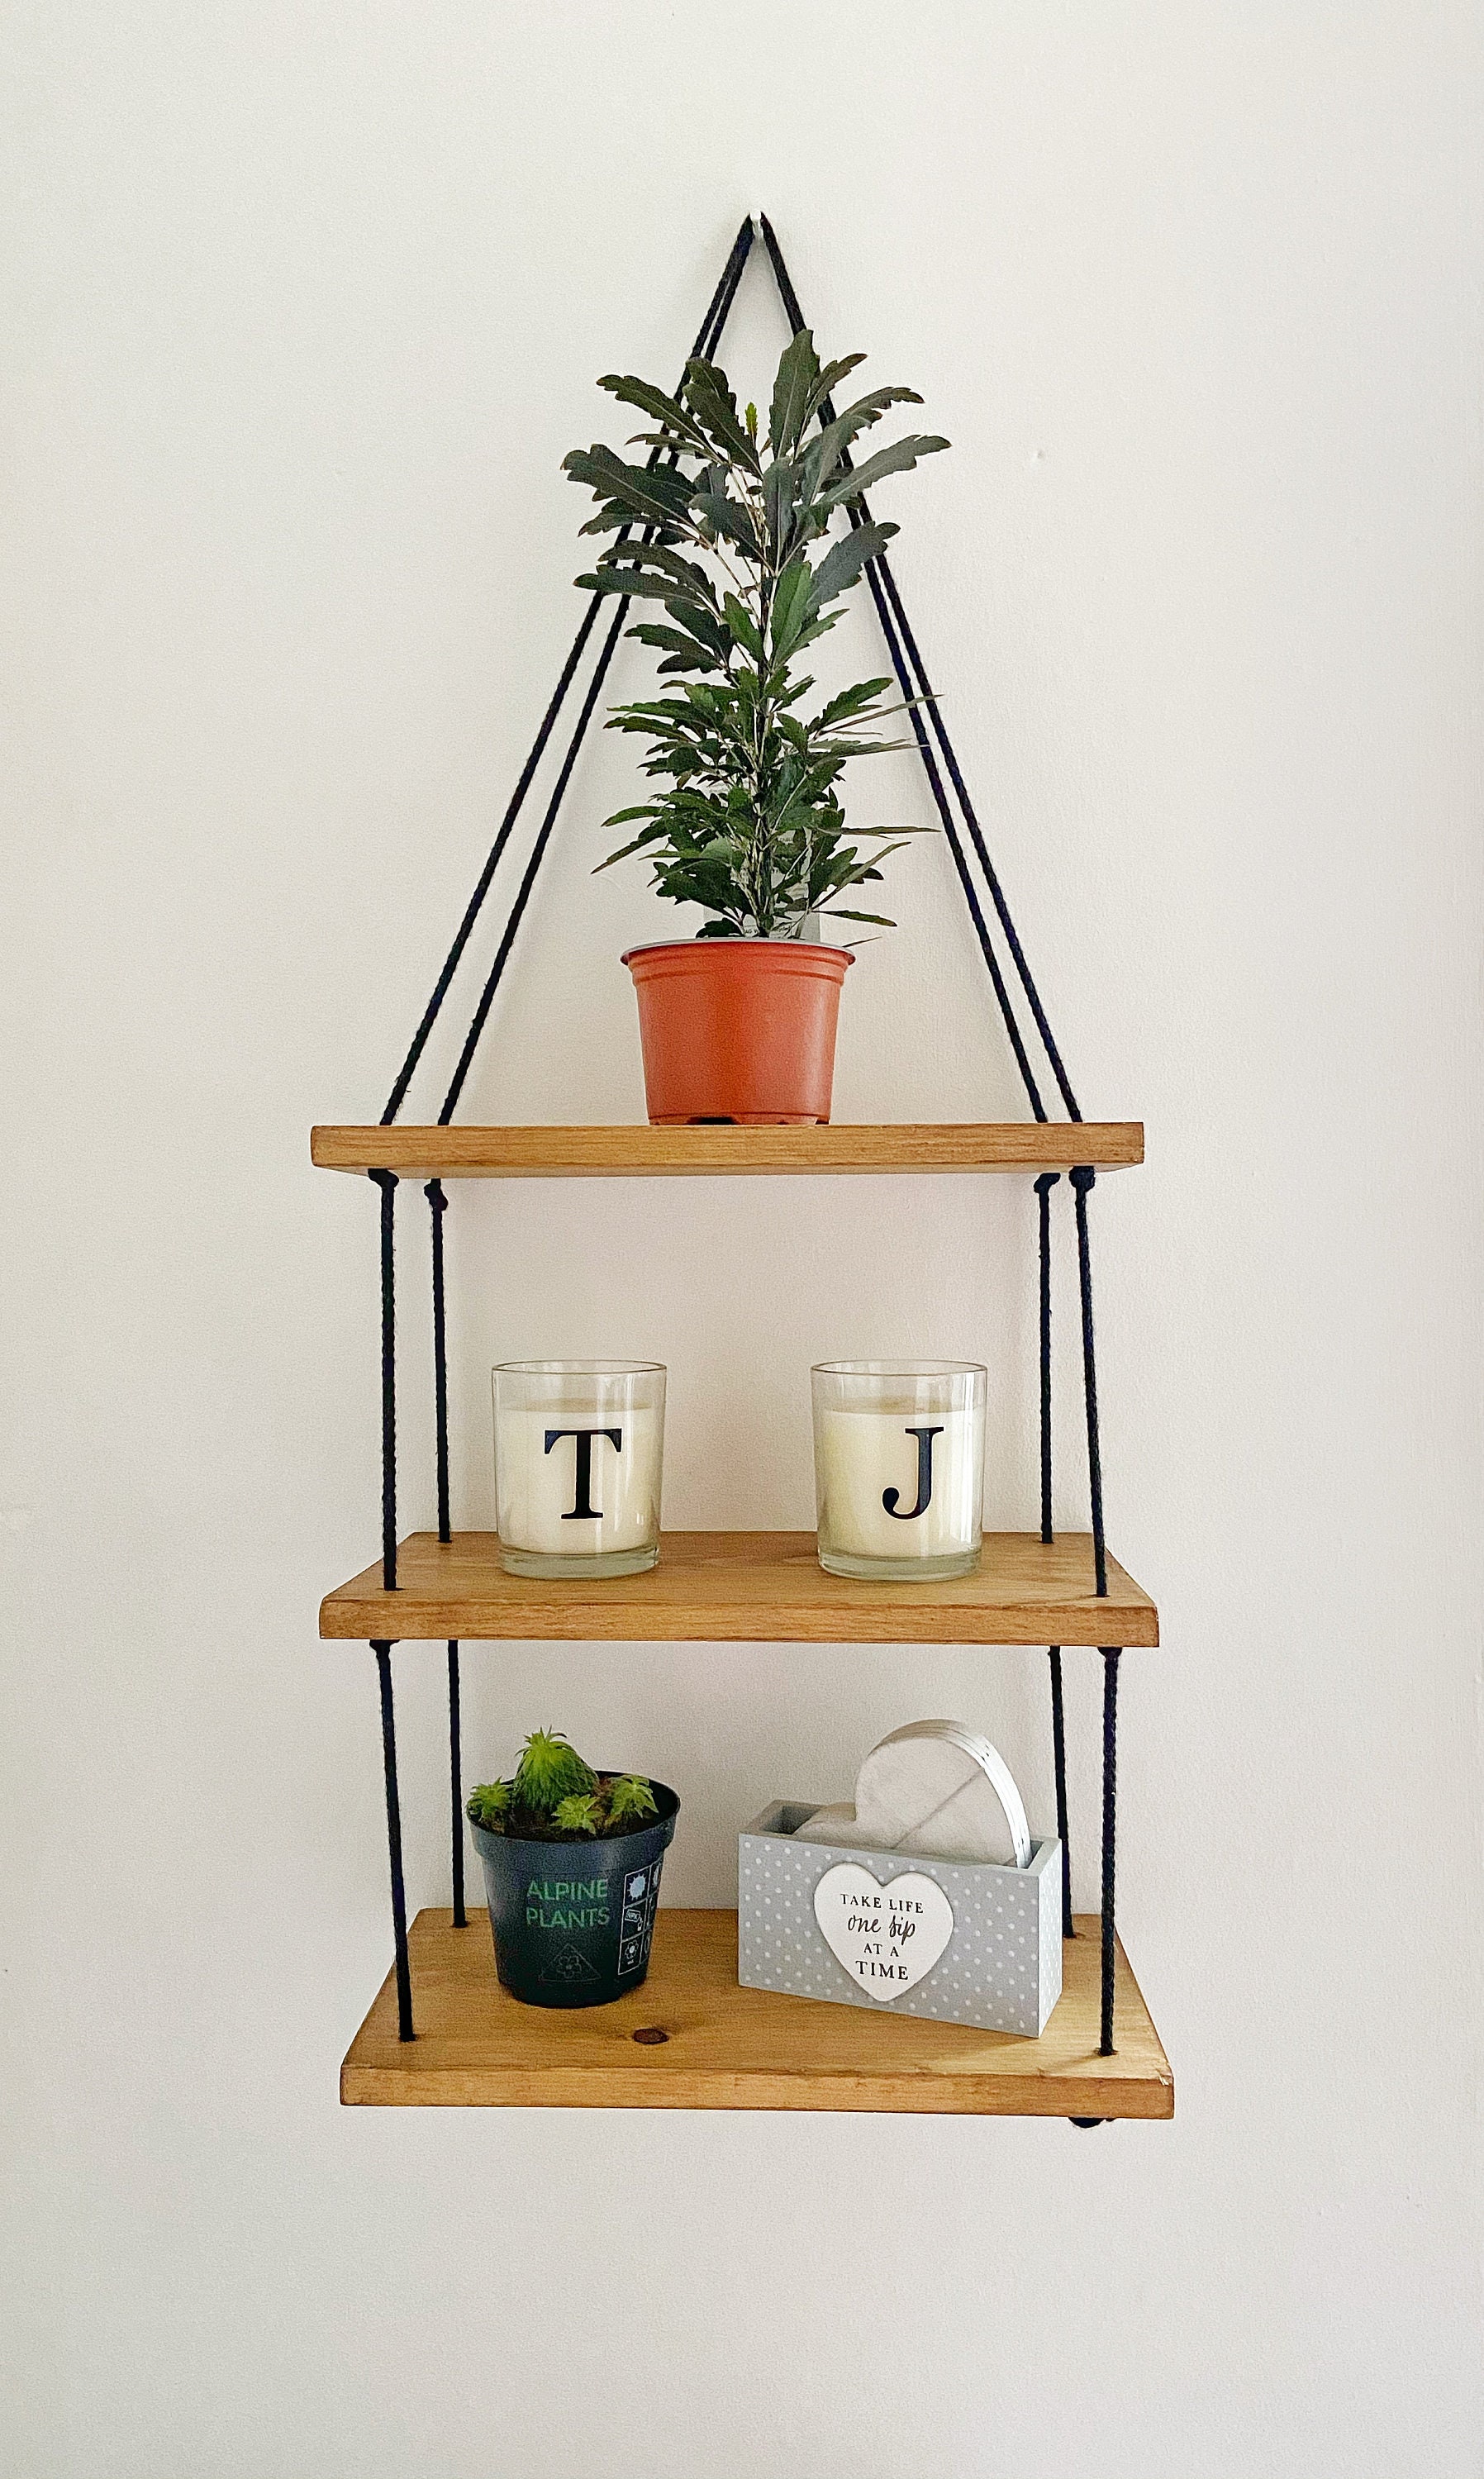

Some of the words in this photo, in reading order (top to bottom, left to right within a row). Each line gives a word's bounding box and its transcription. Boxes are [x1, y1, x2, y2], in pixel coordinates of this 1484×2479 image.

[545, 1428, 622, 1520] T
[882, 1427, 944, 1520] J
[526, 1879, 608, 1899] ALPINE
[840, 1893, 882, 1909] TAKE
[889, 1899, 924, 1913] LIFE
[526, 1907, 610, 1929] PLANTS
[848, 1915, 881, 1933] one
[889, 1915, 916, 1945] sip
[863, 1943, 882, 1954] AT
[890, 1946, 900, 1957] A
[855, 1960, 909, 1980] TIME
